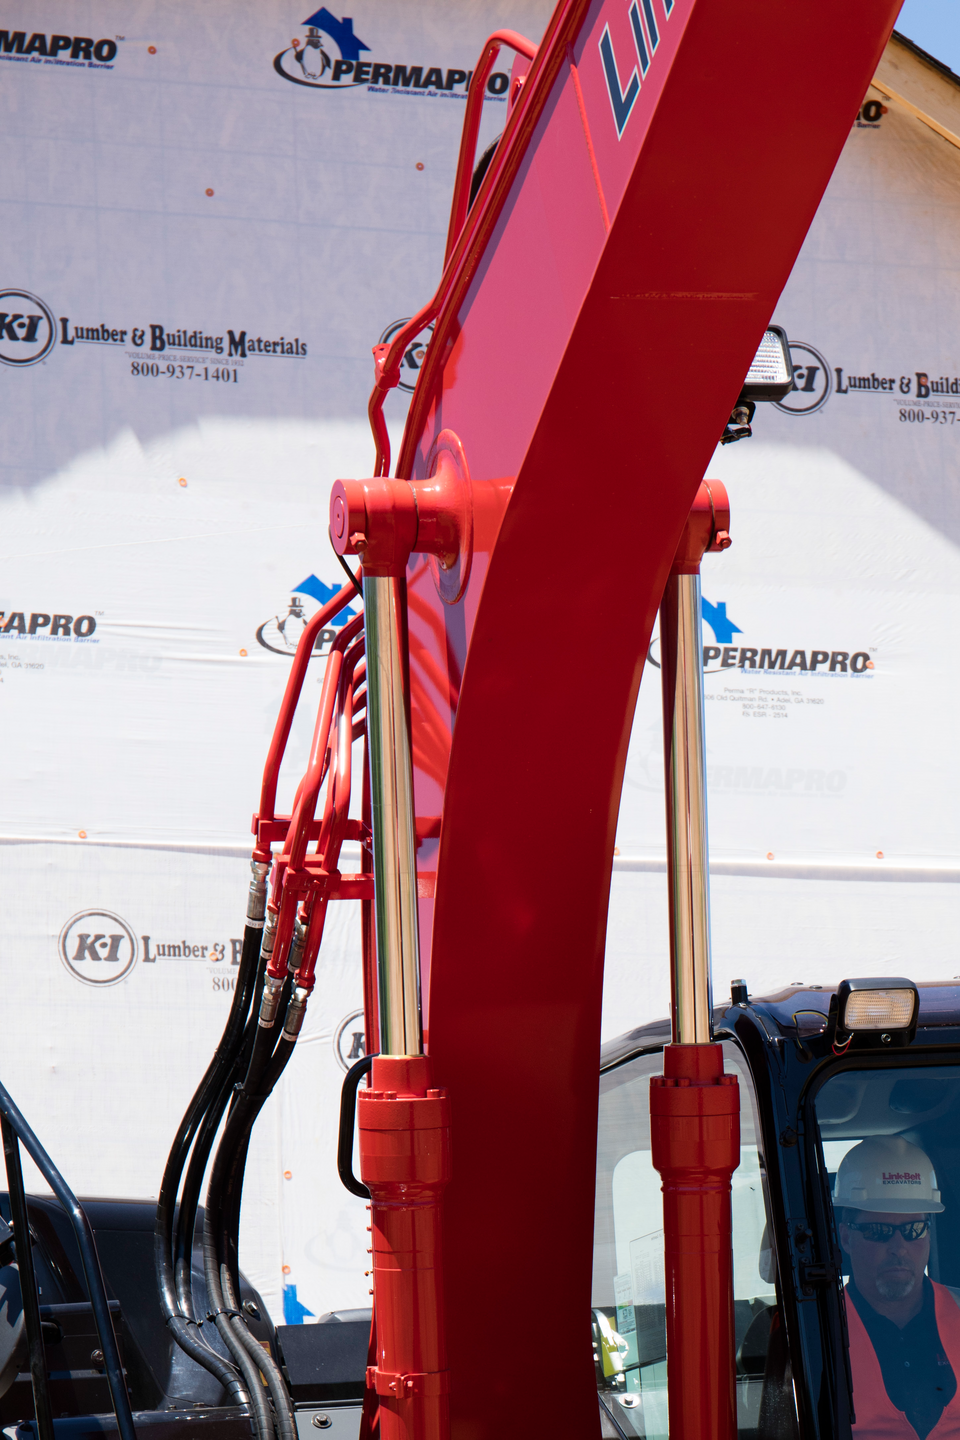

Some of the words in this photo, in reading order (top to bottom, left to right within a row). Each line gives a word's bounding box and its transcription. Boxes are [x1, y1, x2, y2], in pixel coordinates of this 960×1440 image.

[331, 59, 510, 95] PERMAPO
[59, 317, 127, 346] Lumber
[131, 328, 146, 347] &
[149, 324, 224, 354] Building
[227, 330, 308, 358] Materials
[131, 361, 239, 383] 800-937-1401
[834, 367, 895, 394] Lumber
[899, 376, 911, 394] &
[703, 645, 871, 673] PERMAPRO
[141, 935, 208, 963] Lumber
[882, 1172, 921, 1180] Link-Belt
